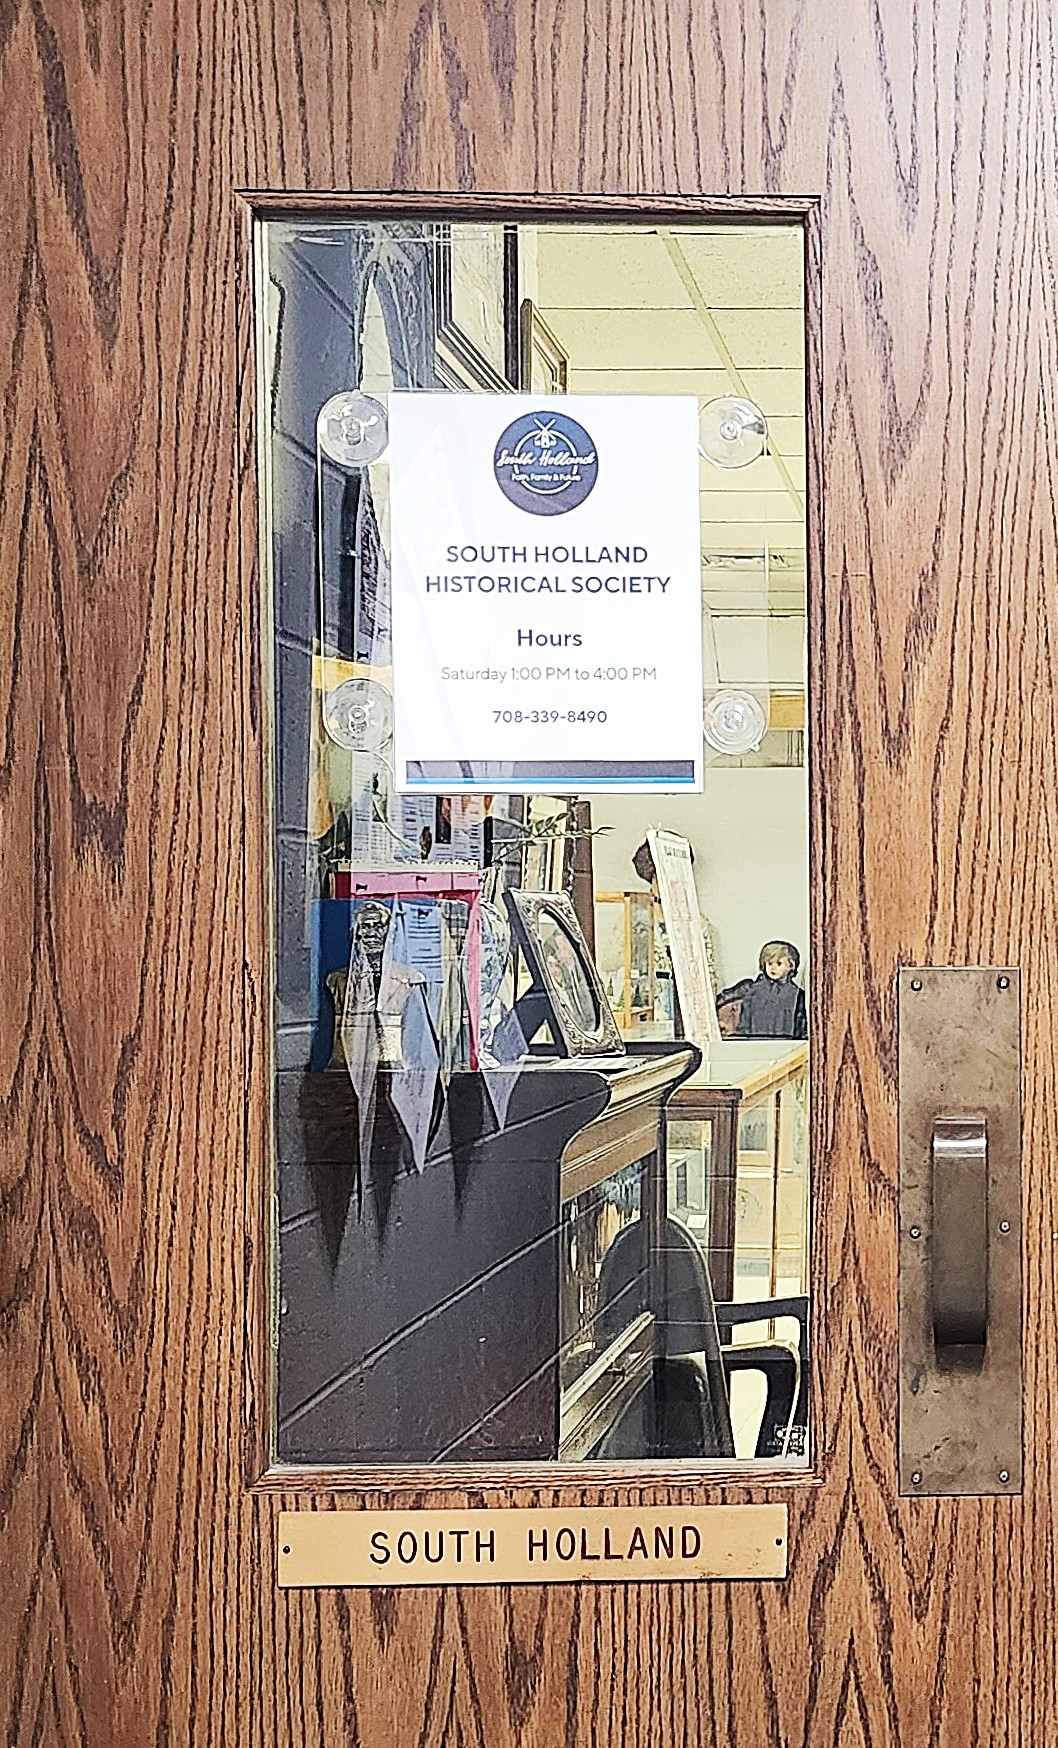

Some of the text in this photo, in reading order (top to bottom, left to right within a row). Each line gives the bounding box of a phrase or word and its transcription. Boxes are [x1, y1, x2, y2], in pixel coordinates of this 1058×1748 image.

[496, 449, 596, 467] South Holland
[446, 545, 648, 563] SOUTH HOLLAND
[426, 575, 671, 593] HISTORICAL SOCIETY
[517, 628, 583, 647] Hours
[441, 666, 658, 683] Saturday 1:00 PM to 4:00 PM
[492, 710, 608, 724] 708-339-8490
[369, 1525, 702, 1564] SOUTH HOLLAND
